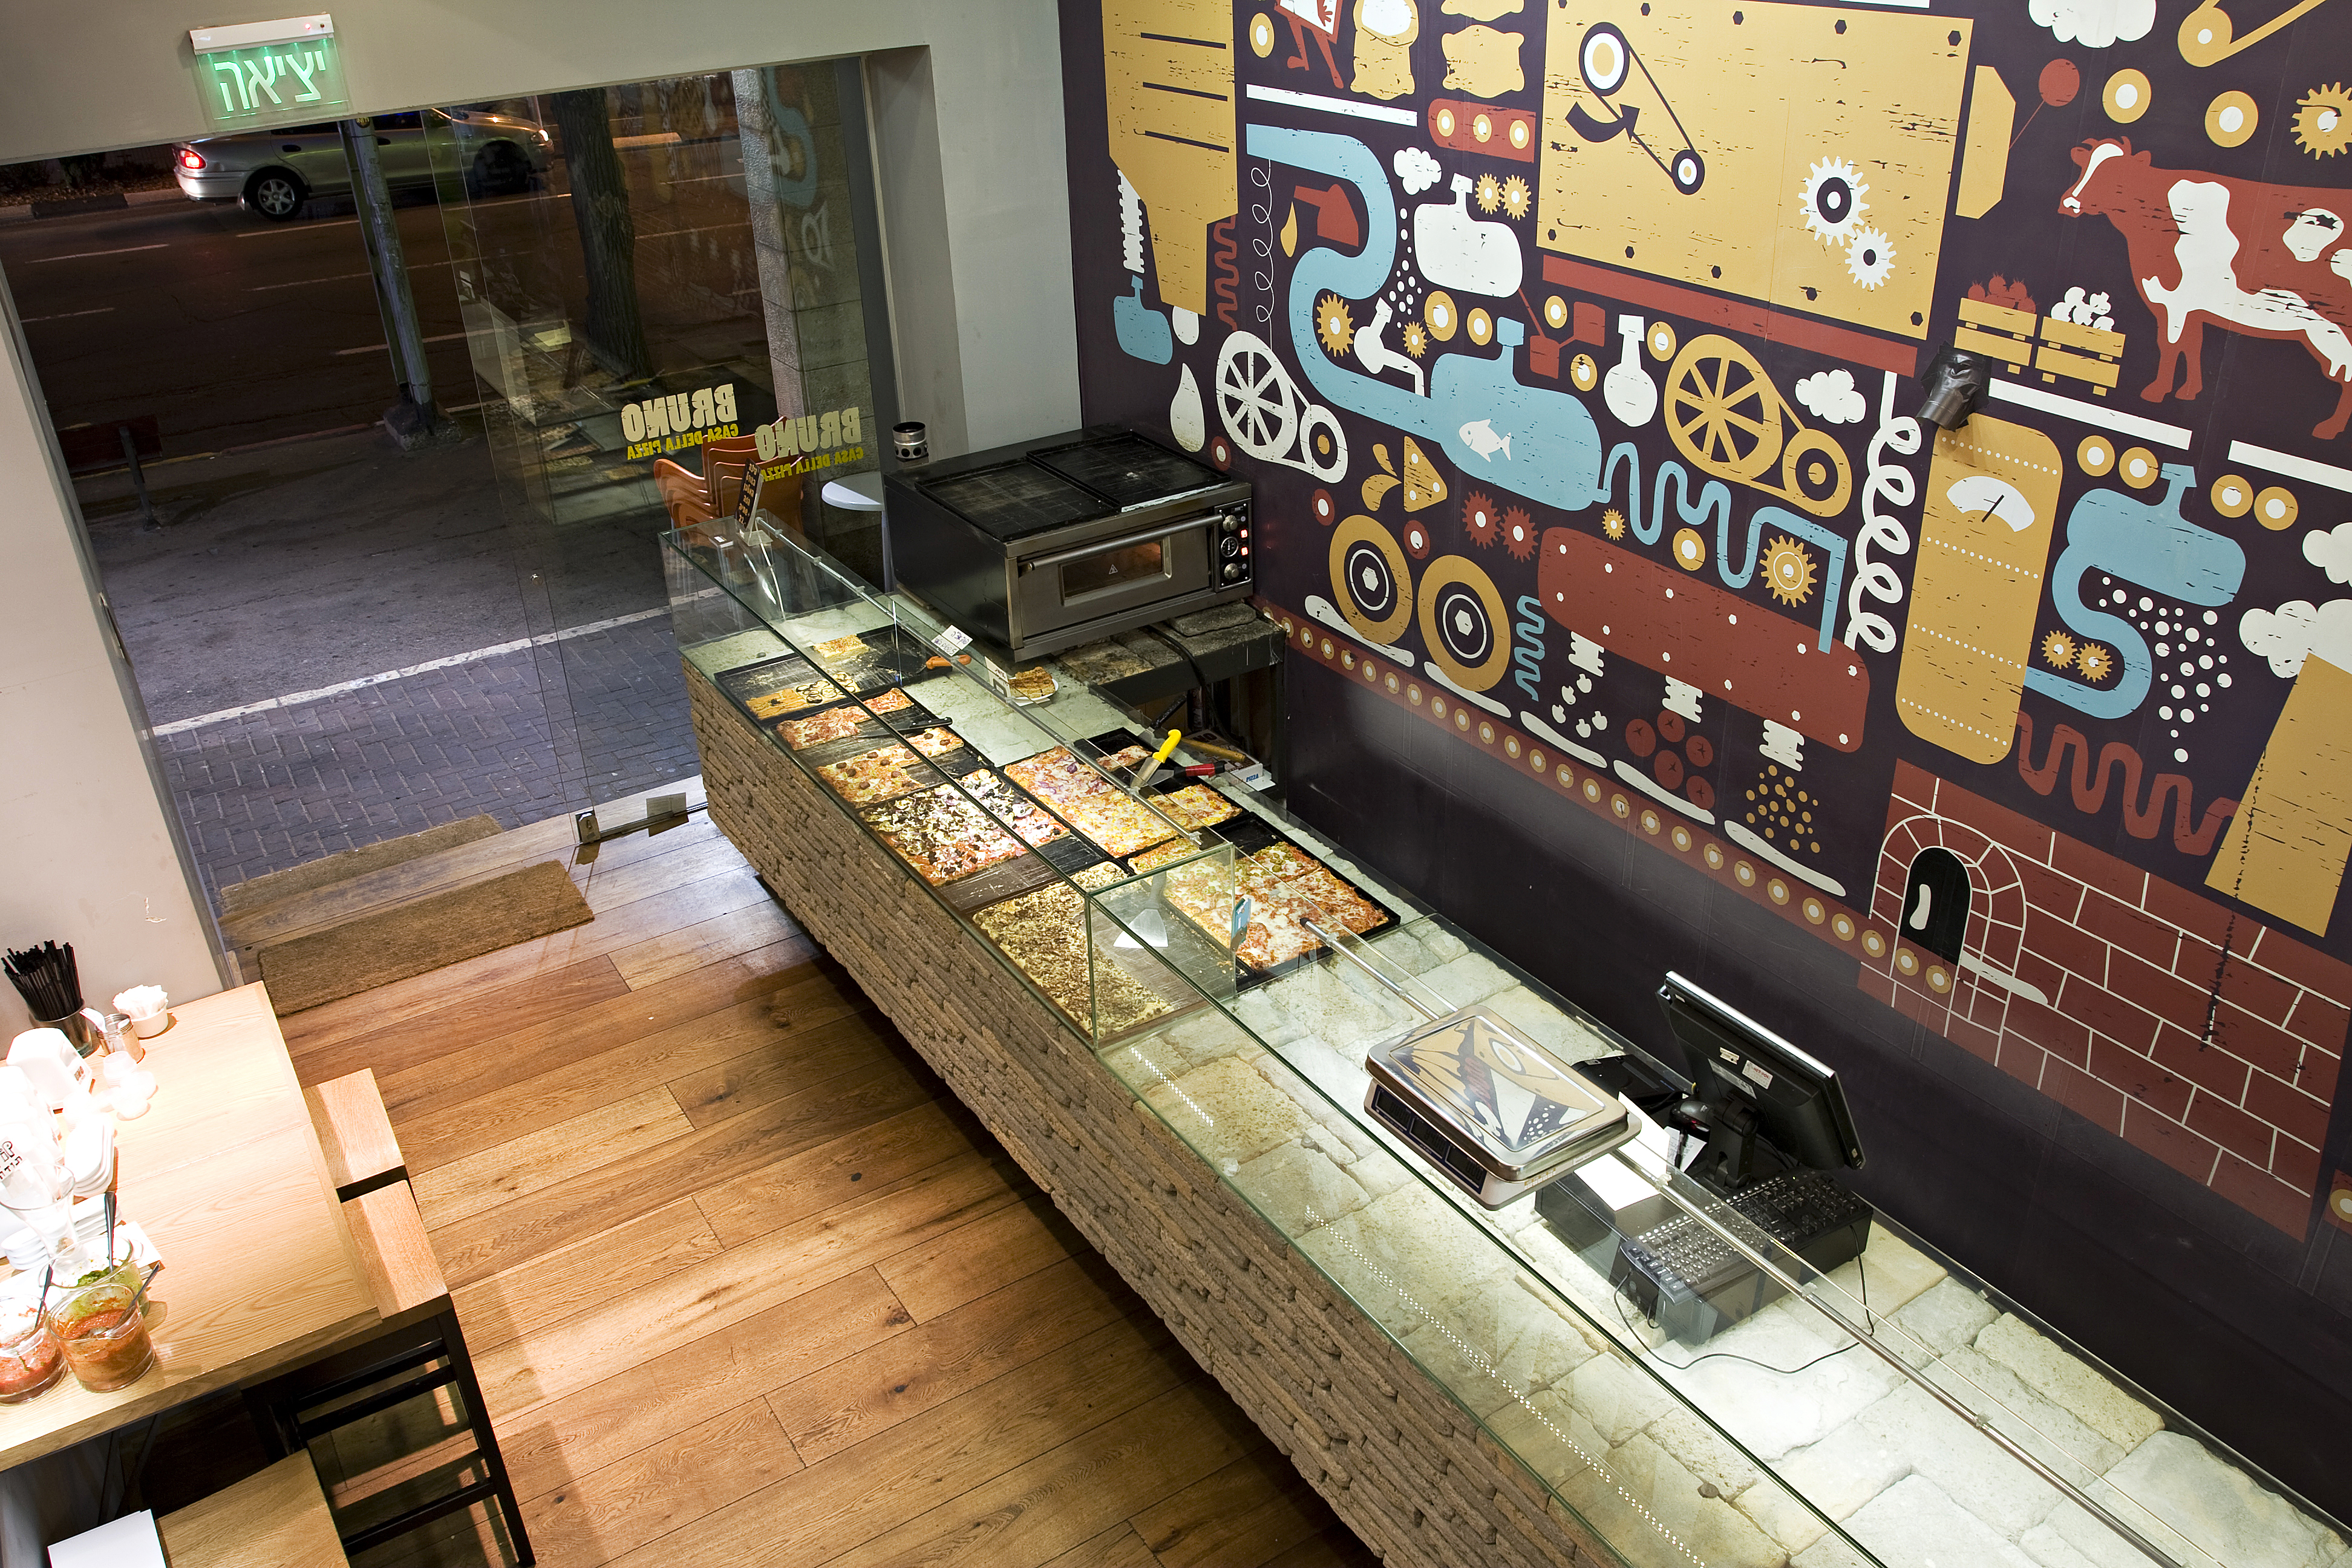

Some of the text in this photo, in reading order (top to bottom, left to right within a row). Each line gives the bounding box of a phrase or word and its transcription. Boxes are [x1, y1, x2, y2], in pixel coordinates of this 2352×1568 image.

[214, 50, 326, 111] יציאה
[1246, 773, 1259, 782] PIZZA
[0, 1156, 23, 1180] תודה
